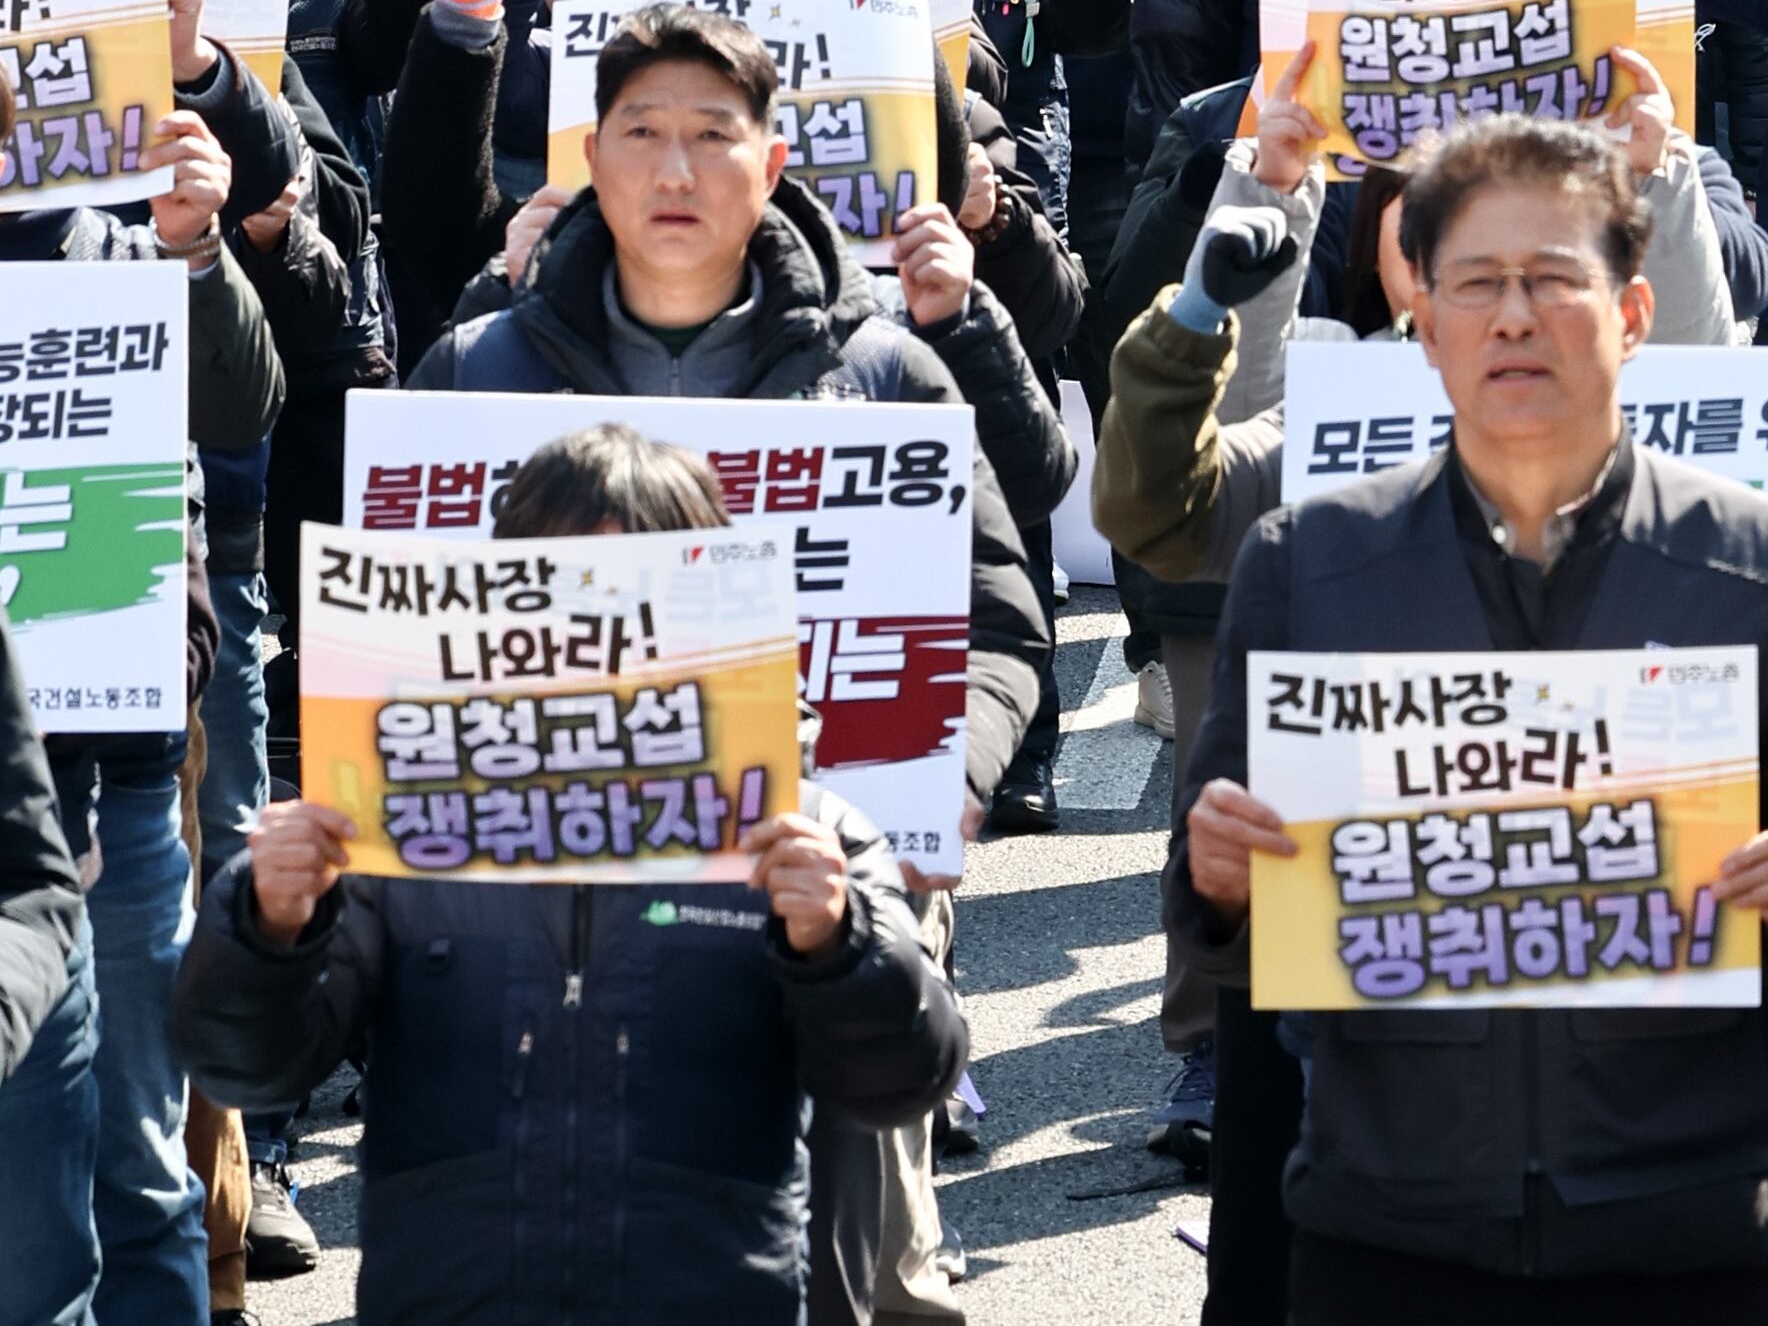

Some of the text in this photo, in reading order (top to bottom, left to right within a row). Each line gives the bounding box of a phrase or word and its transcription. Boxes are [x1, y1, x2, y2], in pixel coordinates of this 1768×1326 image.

[707, 441, 966, 515] 불법고용,
[1307, 415, 1415, 475] 모든
[319, 546, 555, 616] 진짜사장
[440, 603, 661, 683] 나와라!
[28, 686, 163, 710] 국건설노동조합
[375, 682, 706, 783] 원청교섭
[1267, 671, 1512, 735] 진짜사장
[1396, 721, 1613, 798] 나와라!
[383, 767, 767, 871] 쟁취하자!
[1329, 797, 1664, 904] 원청교섭
[1338, 884, 1720, 999] 쟁취하자!
